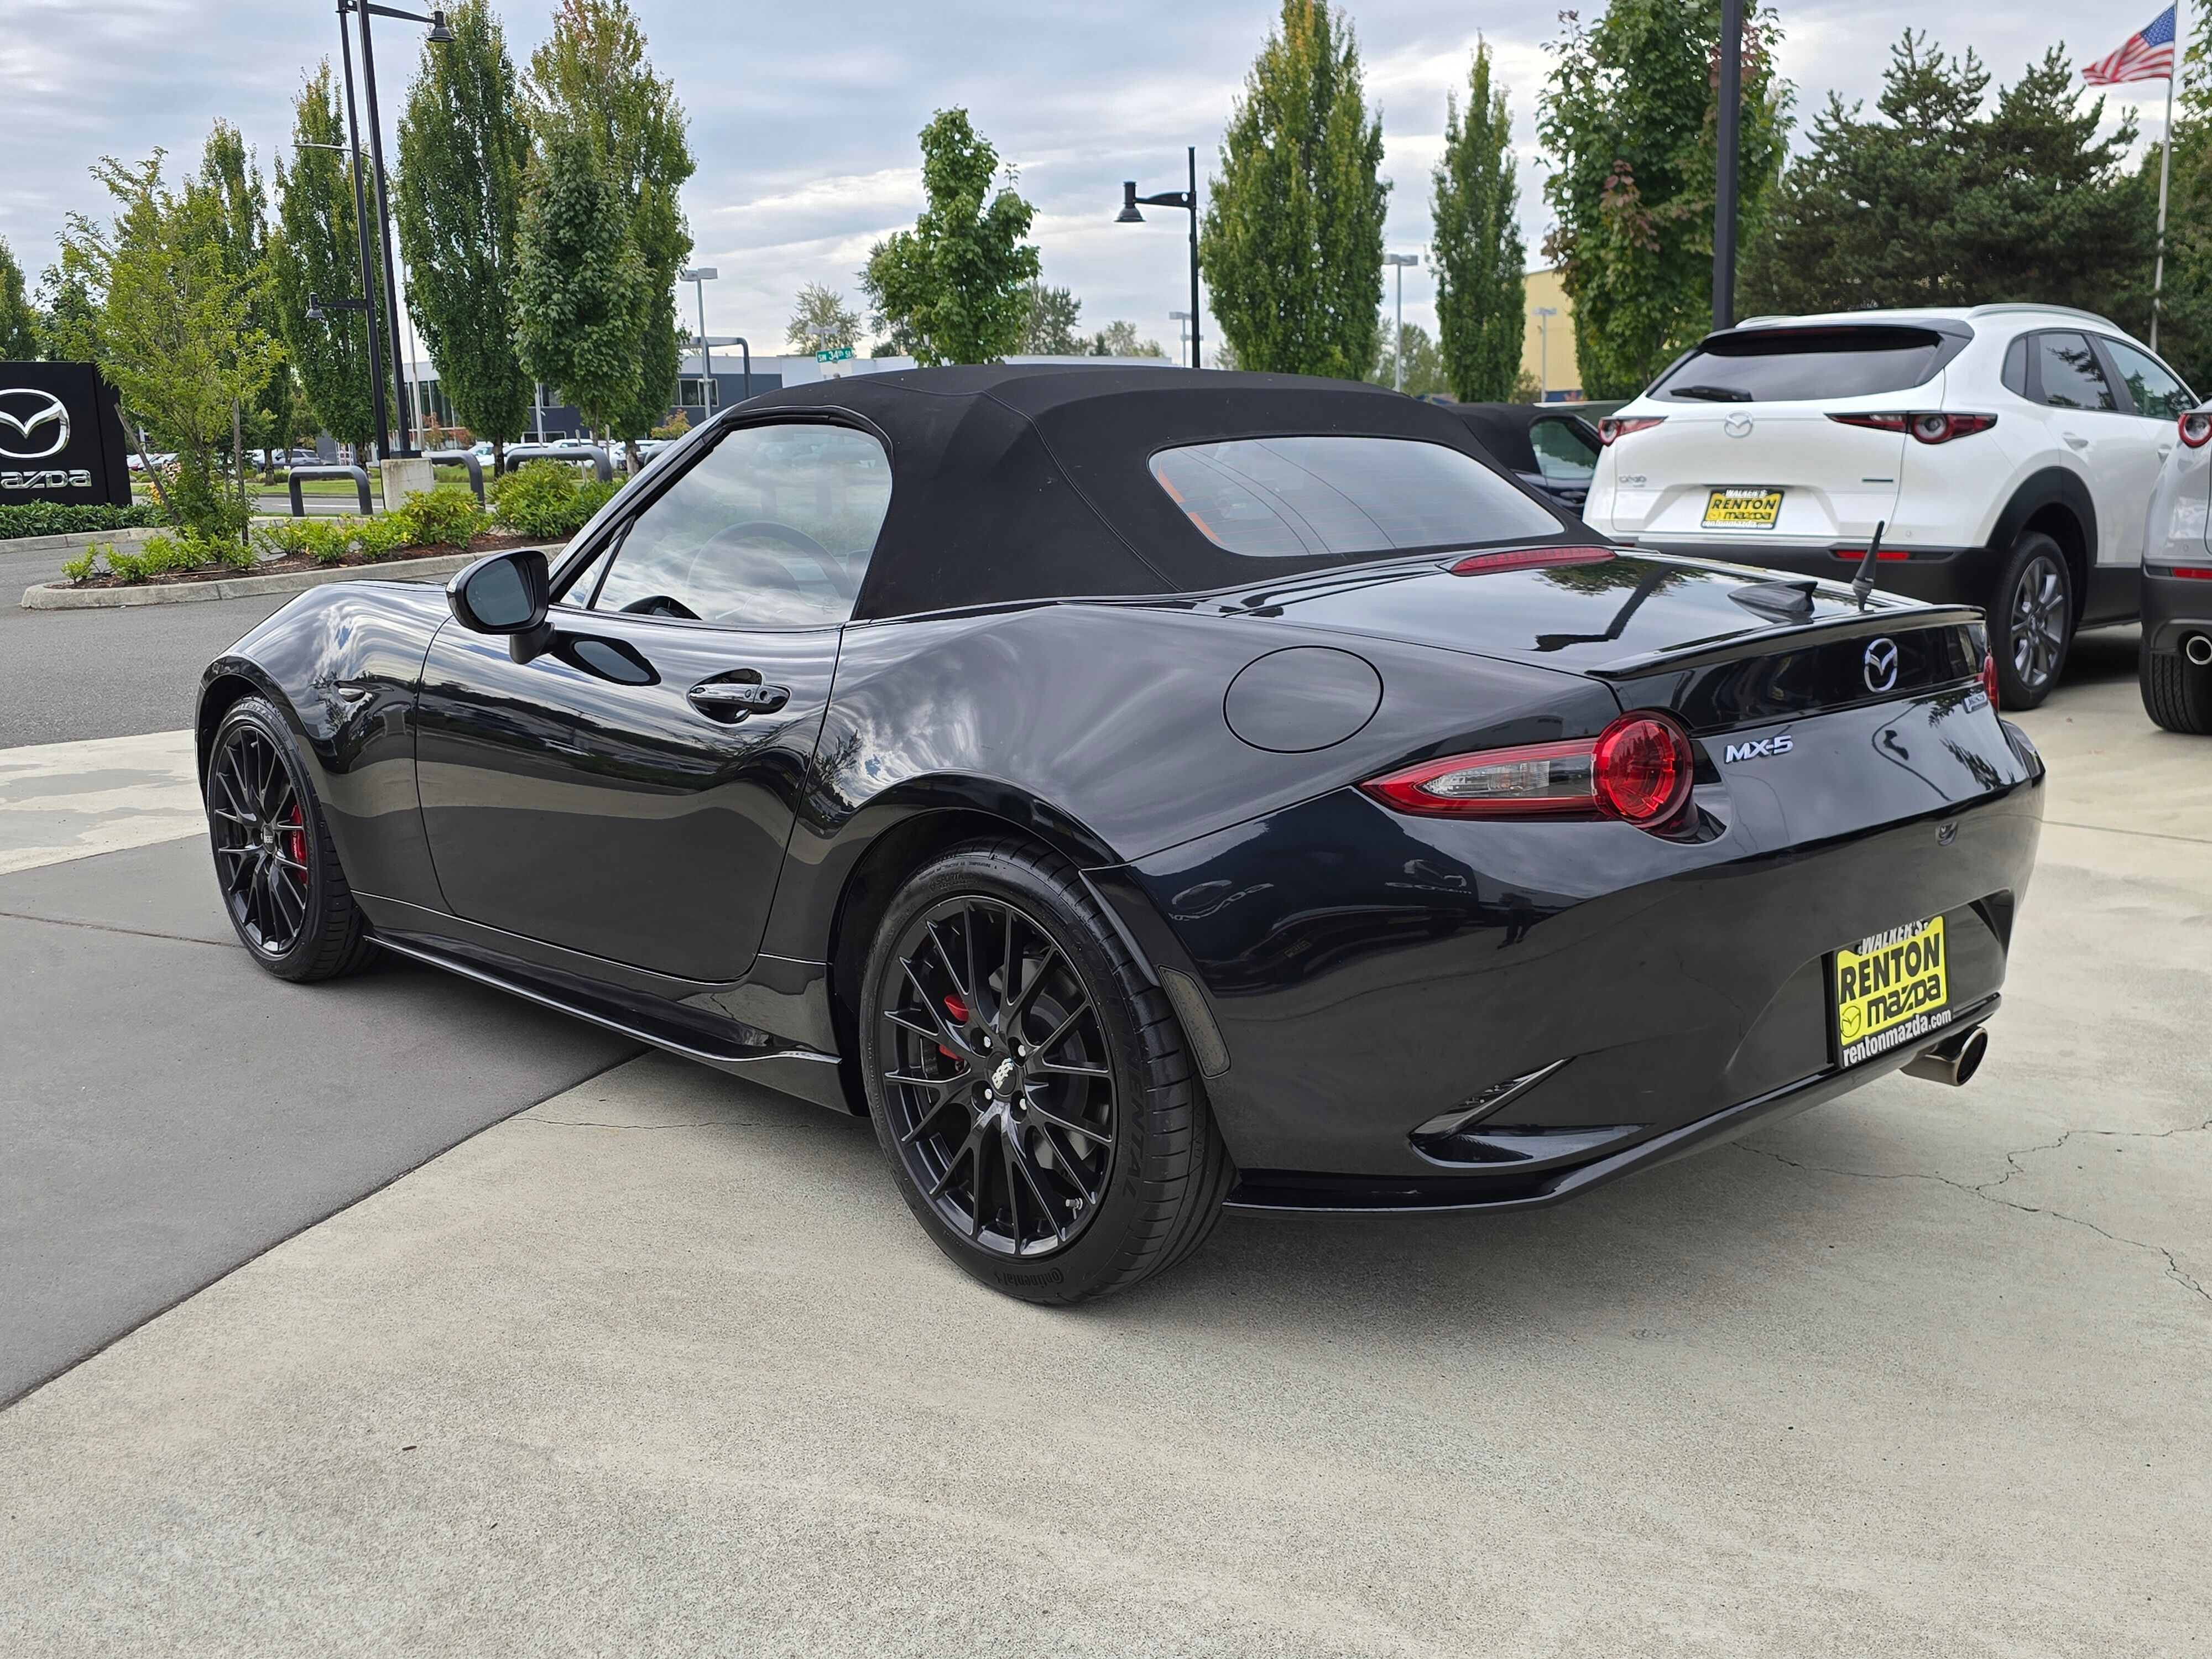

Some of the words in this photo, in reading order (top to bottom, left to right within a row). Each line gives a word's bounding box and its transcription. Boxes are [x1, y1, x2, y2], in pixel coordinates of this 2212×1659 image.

[828, 349, 844, 360] 34th
[1, 469, 92, 489] azda
[1712, 499, 1777, 509] RENTON
[1725, 735, 1793, 763] MX-5
[1861, 921, 1923, 956] WALKER'S
[1840, 932, 1940, 1005] RENTON
[1867, 973, 1941, 1028] mazda
[1843, 1009, 1952, 1067] rentonmazda.com
[1003, 1267, 1065, 1289] Continental
